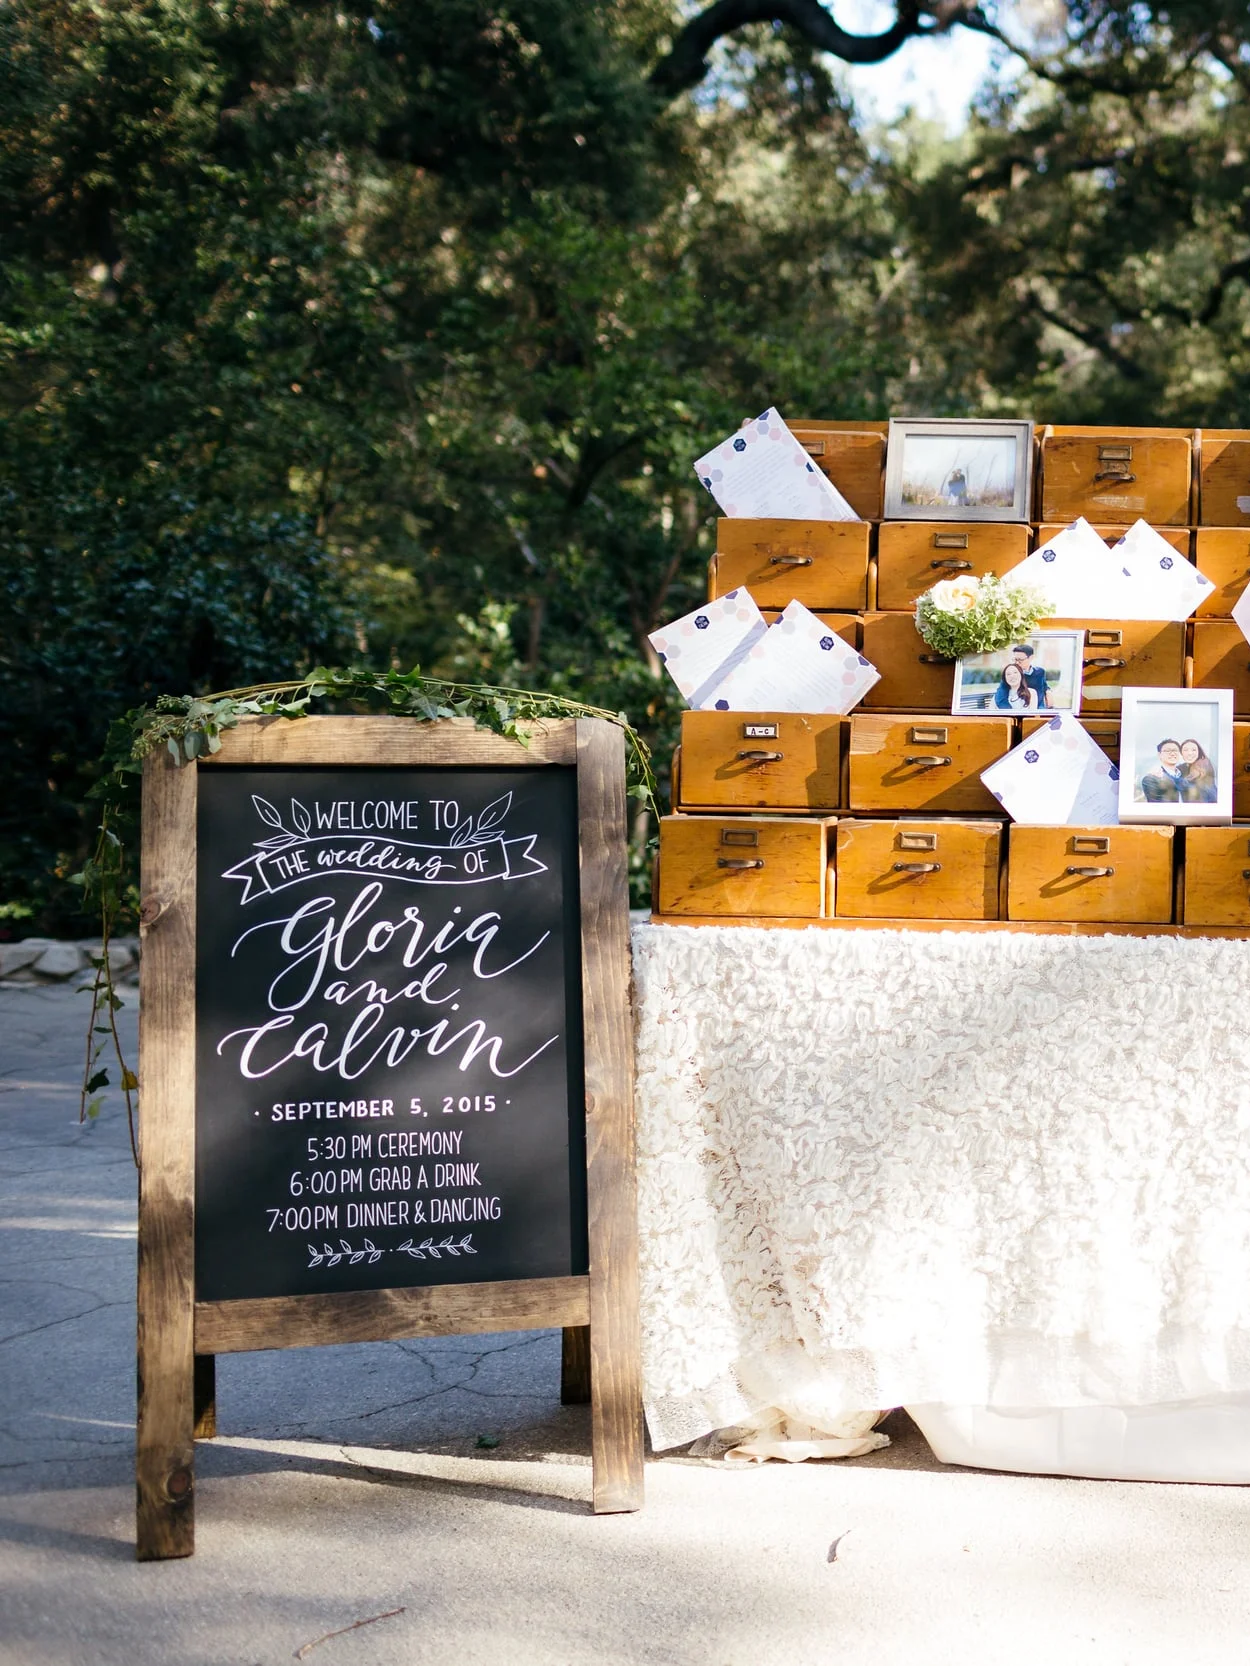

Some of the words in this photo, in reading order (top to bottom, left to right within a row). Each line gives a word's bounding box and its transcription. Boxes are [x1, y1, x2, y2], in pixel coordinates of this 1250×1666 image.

[314, 800, 419, 830] WELCOME
[428, 799, 459, 830] TO
[268, 849, 311, 880] THE
[316, 841, 457, 880] wedding
[463, 848, 489, 874] OF
[230, 881, 551, 1013] Gloria
[323, 962, 461, 1006] and
[216, 1002, 560, 1080] Calvin
[270, 1098, 395, 1122] SEPTEMBER
[409, 1097, 429, 1118] 5,
[442, 1095, 496, 1114] 2015
[307, 1135, 347, 1162] 5:30
[351, 1133, 373, 1159] PM
[377, 1130, 463, 1159] CEREMONY
[289, 1169, 337, 1197] 6:00
[340, 1167, 363, 1194] PM
[368, 1165, 412, 1192] GRAB
[416, 1164, 429, 1190] A
[434, 1162, 482, 1189] DRINK
[346, 1200, 410, 1229] DINNER
[413, 1199, 428, 1225] &
[430, 1196, 502, 1224] DANCING
